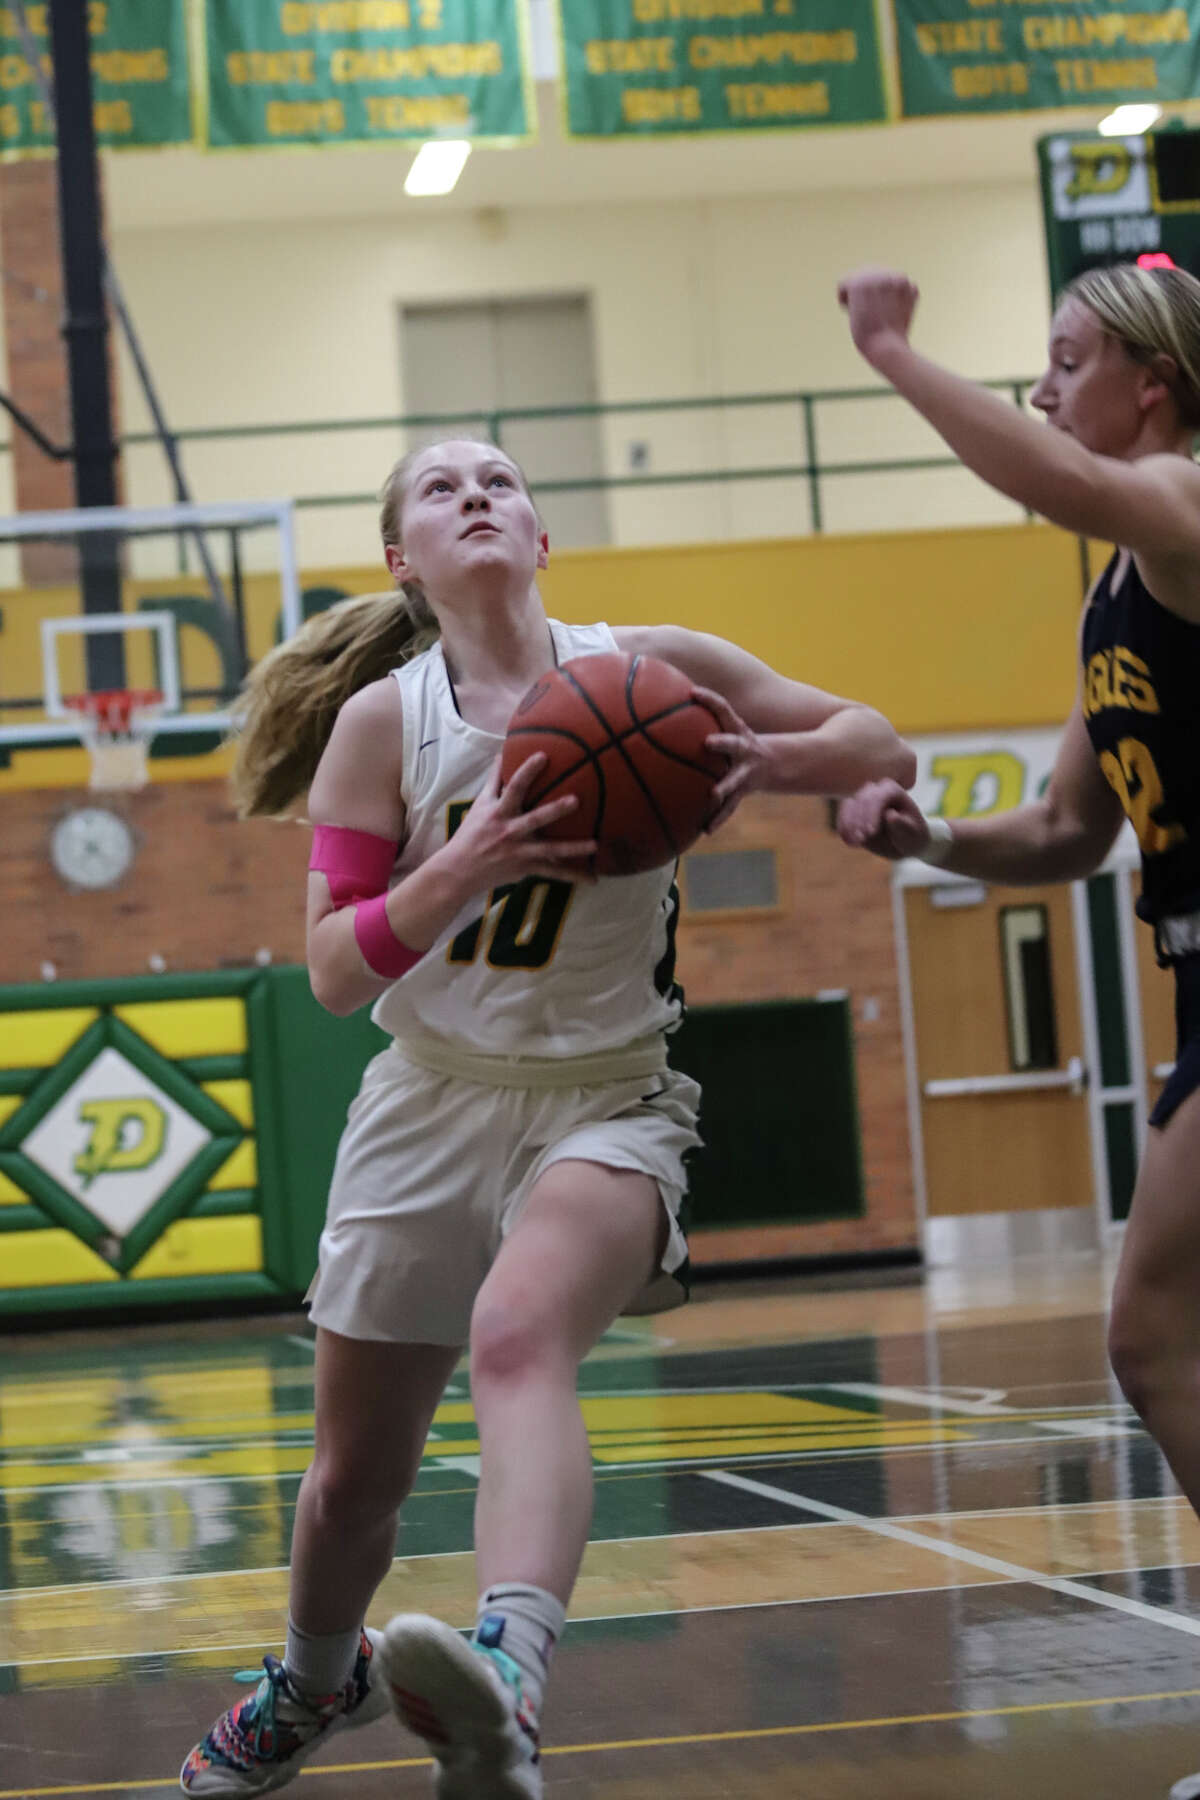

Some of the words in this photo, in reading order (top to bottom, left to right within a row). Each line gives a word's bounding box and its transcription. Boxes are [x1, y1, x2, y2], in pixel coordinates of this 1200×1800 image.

[585, 37, 676, 74] STATE
[689, 29, 857, 69] CHAMPIONS
[917, 19, 1004, 54] STATE
[1023, 9, 1190, 49] CHAMPIONS
[227, 50, 315, 84] STATE
[331, 41, 501, 83] CHAMPIONS
[1054, 58, 1157, 91] TENNIS
[726, 81, 829, 118] TENNIS
[446, 873, 577, 971] 10
